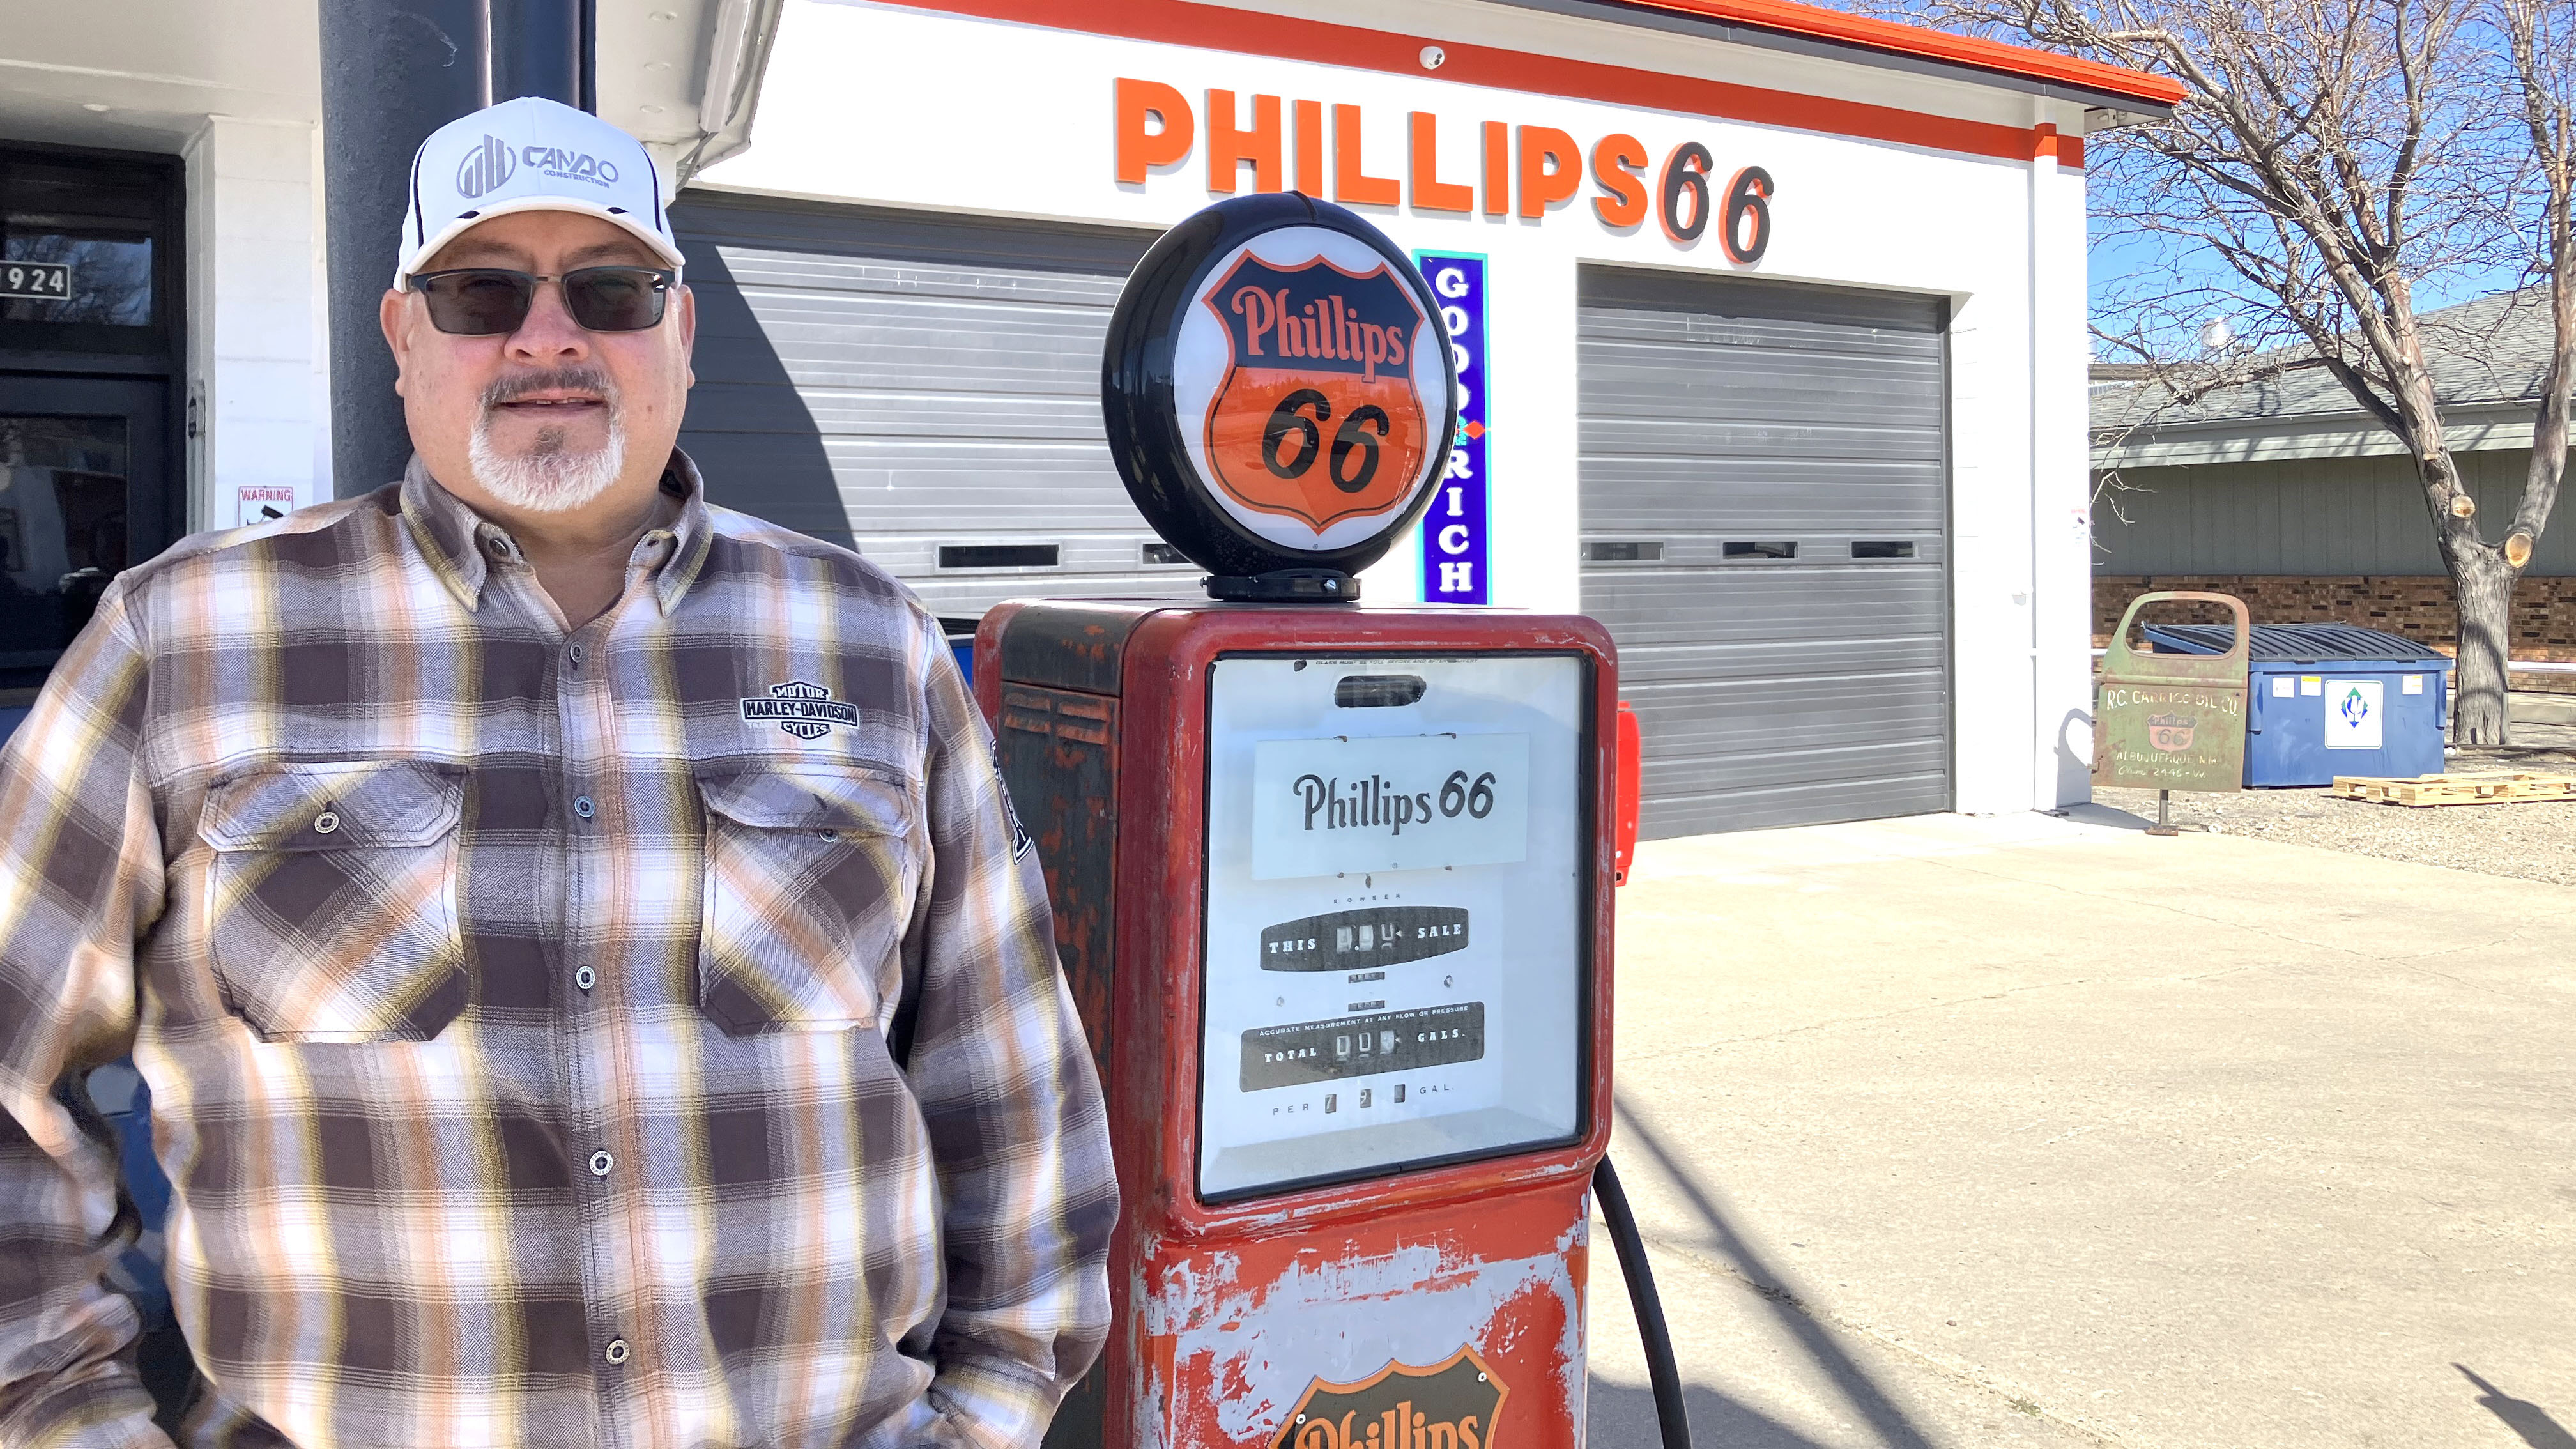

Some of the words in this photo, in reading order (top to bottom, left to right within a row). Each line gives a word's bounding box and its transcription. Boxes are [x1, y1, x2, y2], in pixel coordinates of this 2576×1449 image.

[522, 145, 619, 183] CANDO
[1112, 76, 1649, 228] PHILLIPS
[1655, 141, 1775, 265] 66
[544, 169, 610, 189] CONSTRUCTION
[0, 267, 64, 293] 924
[1230, 286, 1406, 383] Phillips
[1261, 388, 1390, 494] 66
[241, 489, 291, 502] WARNING
[776, 684, 825, 699] MOTOR
[2195, 693, 2218, 709] OIL
[746, 701, 856, 723] HARLEY-DAVIDSON
[783, 723, 829, 738] CYCLES
[2158, 728, 2186, 746] 66
[1292, 772, 1431, 836] Phillips
[1438, 770, 1496, 820] 66
[1333, 893, 1400, 905] BOWSER
[1268, 938, 1316, 954] THIS
[1417, 923, 1462, 939] SALE
[1259, 1025, 1300, 1036] ACCURATE
[1304, 1018, 1360, 1031] MEASUREMENT
[1432, 1005, 1468, 1015] PRESSURE
[1264, 1047, 1317, 1063] TOTAL
[1417, 1028, 1466, 1043] GALS.
[1272, 1103, 1309, 1116] PER
